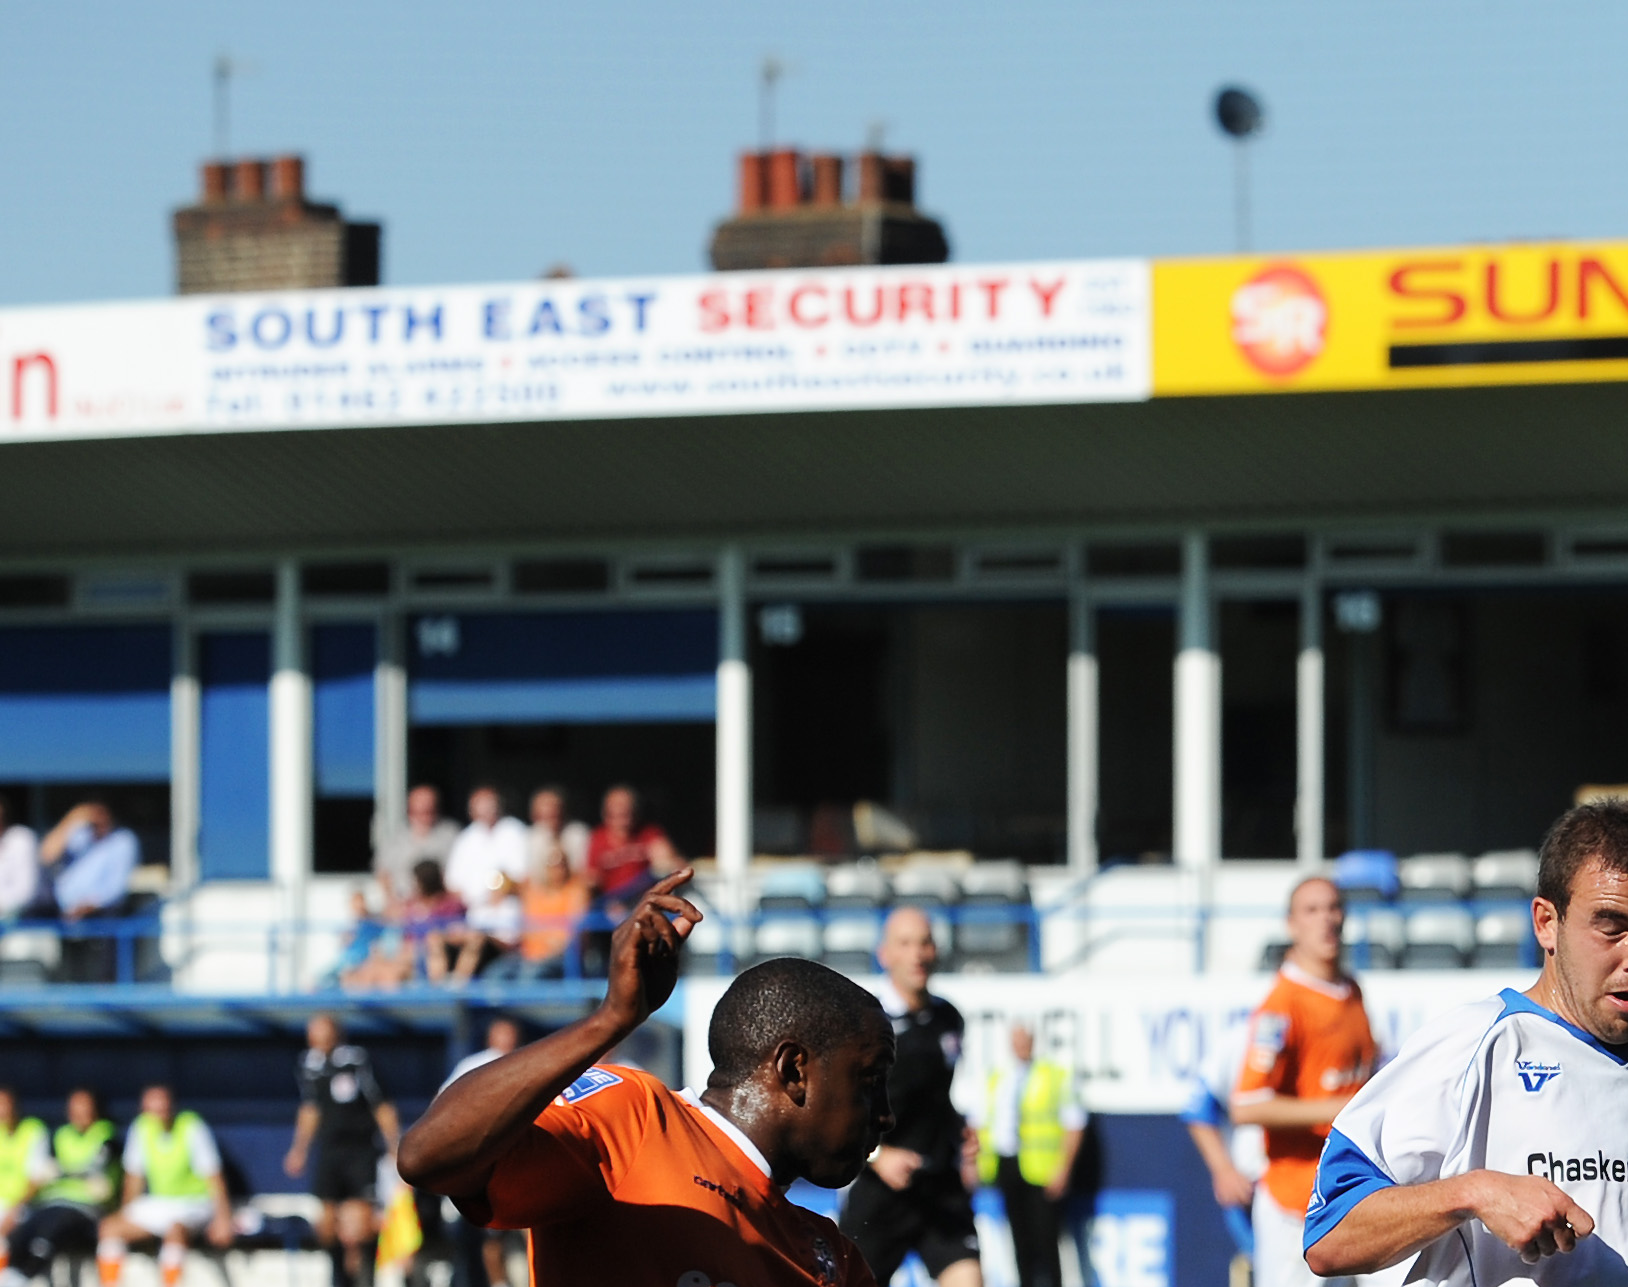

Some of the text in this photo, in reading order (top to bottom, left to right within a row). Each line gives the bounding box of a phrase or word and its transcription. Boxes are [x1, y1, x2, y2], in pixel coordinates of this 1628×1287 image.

[204, 277, 1067, 353] SOUTH EAST SECURITY
